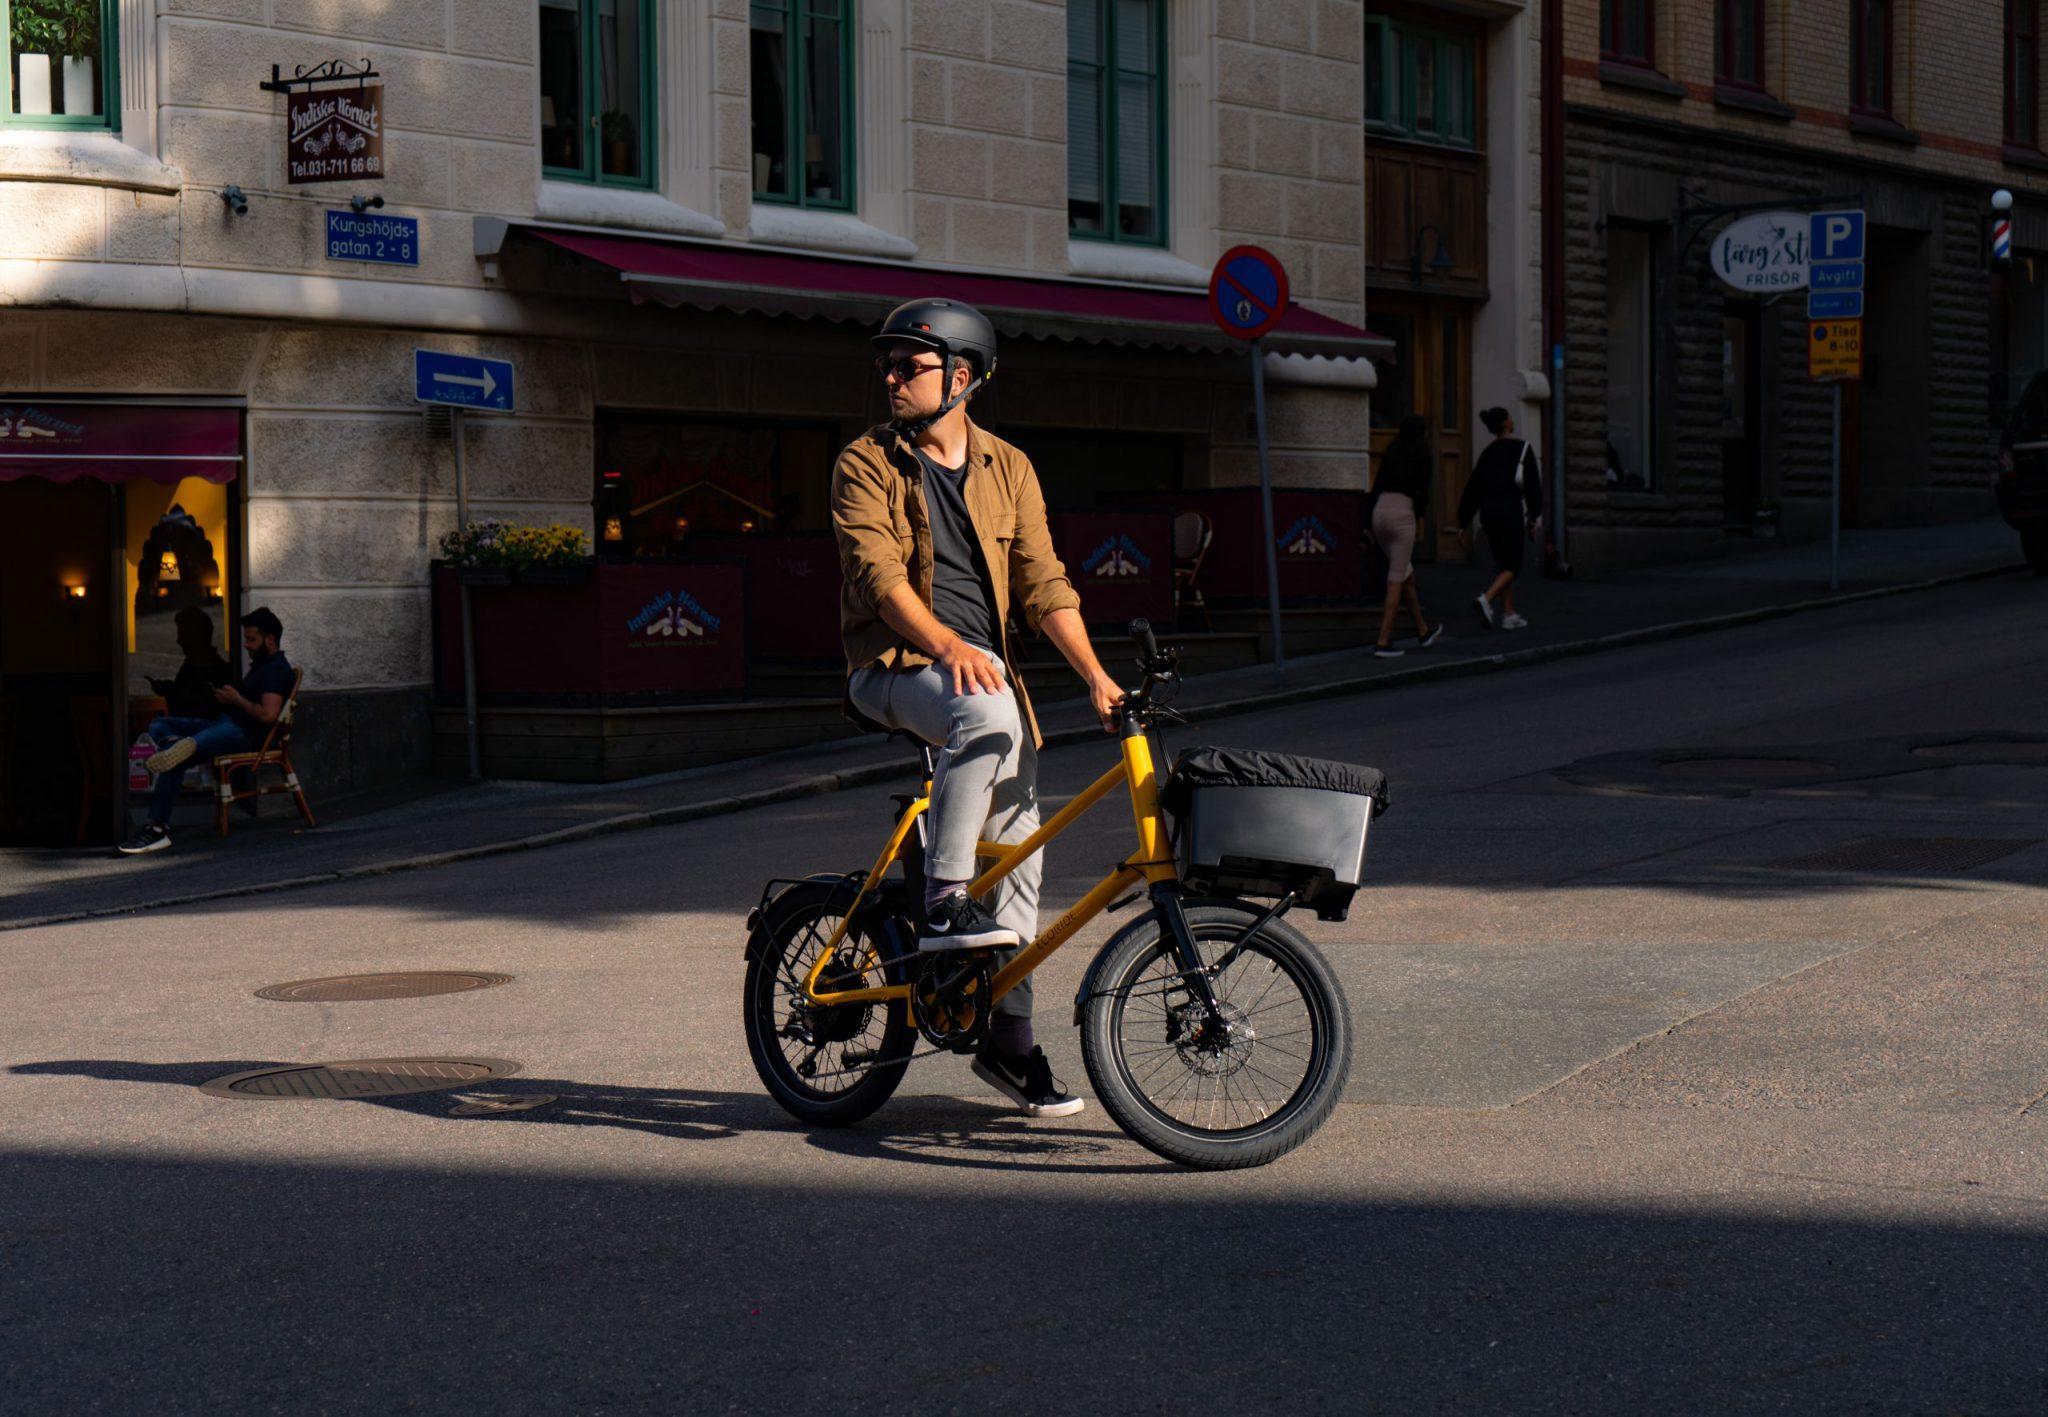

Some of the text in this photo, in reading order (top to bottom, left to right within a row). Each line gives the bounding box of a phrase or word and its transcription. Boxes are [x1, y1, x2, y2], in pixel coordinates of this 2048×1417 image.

[291, 96, 378, 136] Indiska Hörnet
[291, 158, 348, 177] Tel.031-711
[351, 157, 365, 173] 66
[330, 216, 416, 241] Kungshöjds-
[1825, 216, 1853, 257] P
[330, 239, 371, 258] gatan
[376, 241, 385, 258] 2
[401, 243, 410, 259] 8
[1746, 271, 1800, 286] FRISÖR
[1817, 270, 1857, 284] Avgift
